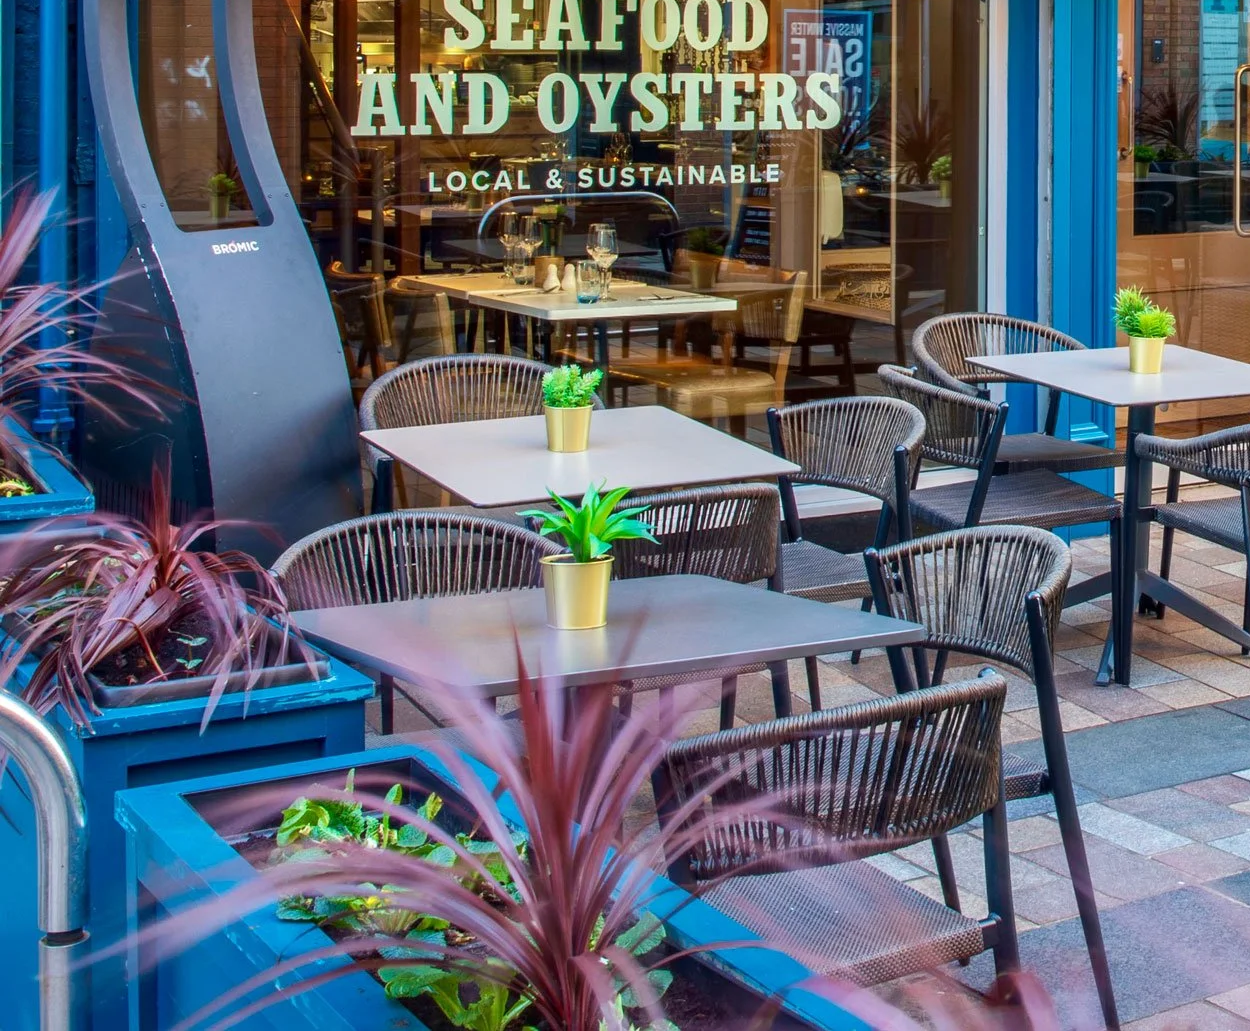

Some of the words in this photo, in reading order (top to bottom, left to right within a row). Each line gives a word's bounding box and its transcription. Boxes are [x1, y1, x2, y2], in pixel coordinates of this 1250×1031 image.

[351, 72, 511, 136] AND
[537, 72, 842, 133] OYSTERS
[429, 168, 531, 192] LOCAL
[546, 168, 563, 190] &
[578, 163, 780, 187] SUSTAINABLE
